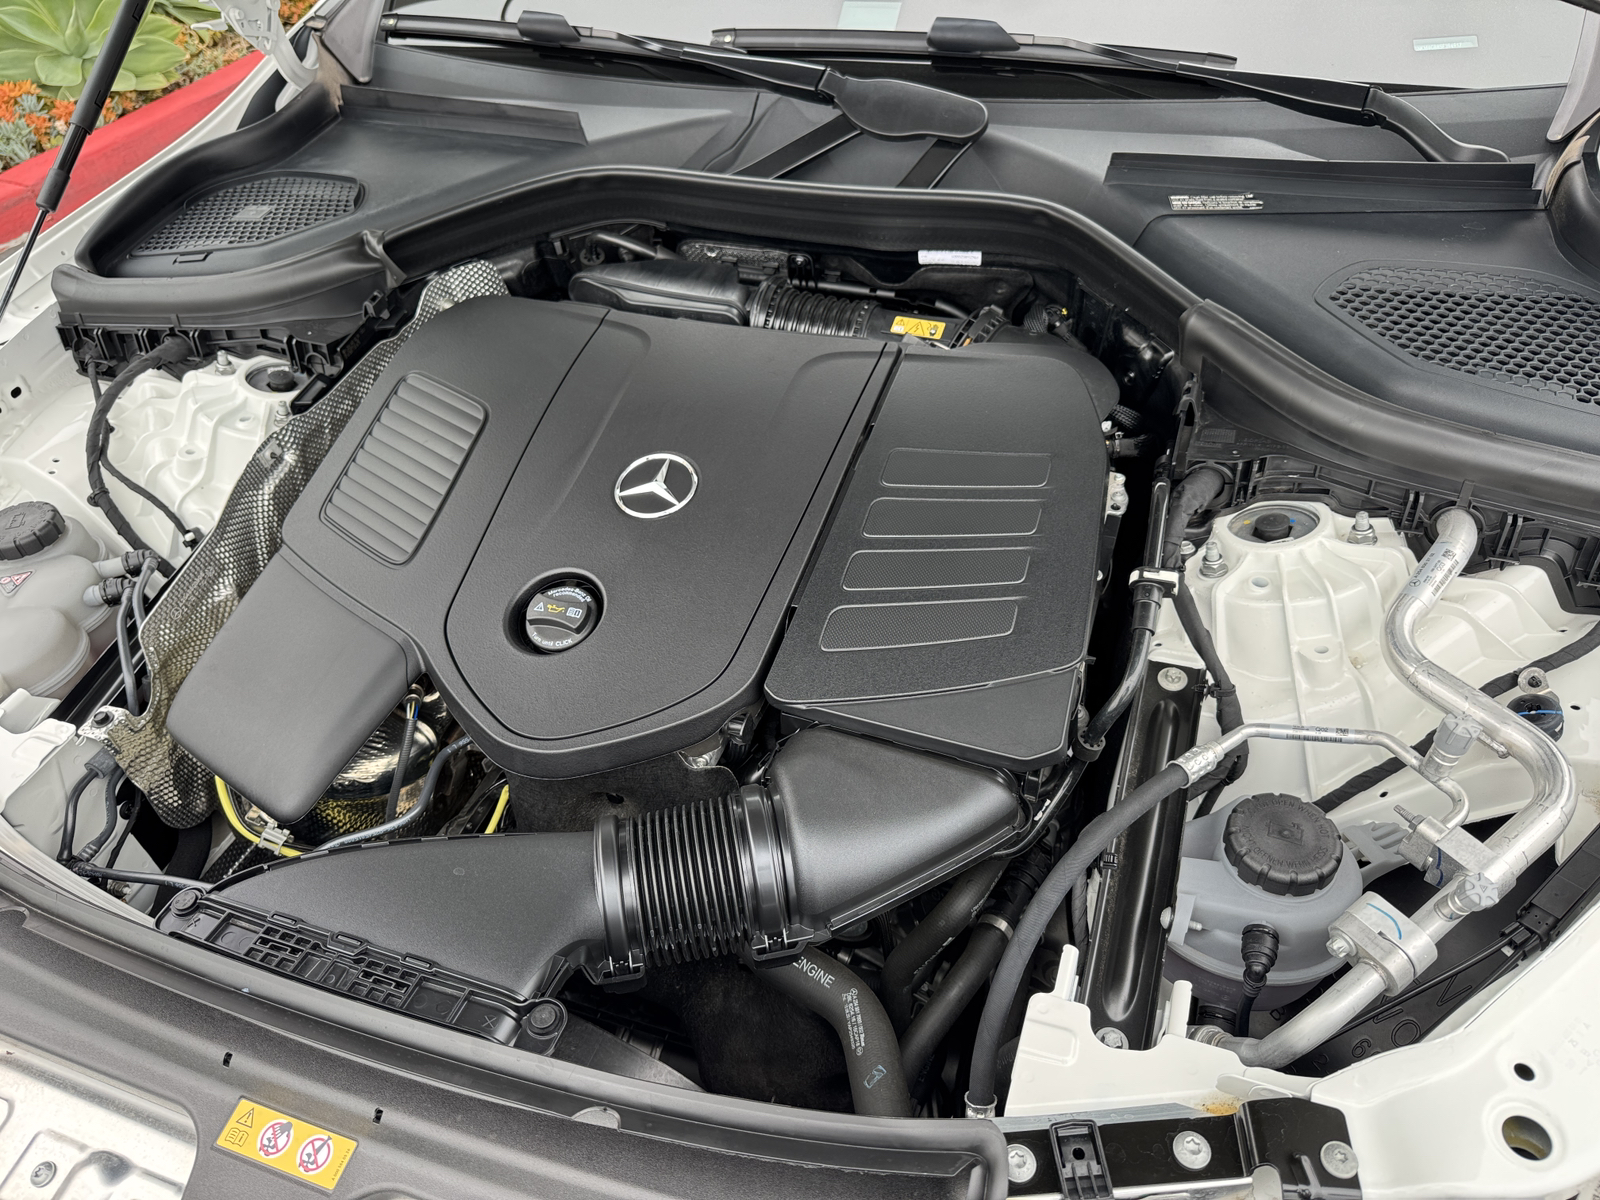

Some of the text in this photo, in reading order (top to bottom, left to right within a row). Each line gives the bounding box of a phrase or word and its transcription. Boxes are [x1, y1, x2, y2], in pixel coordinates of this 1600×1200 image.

[532, 631, 541, 642] Turn
[555, 638, 573, 646] CLICK
[1271, 799, 1295, 809] OPEN
[1297, 802, 1320, 823] WHEN
[1319, 823, 1330, 839] HOT
